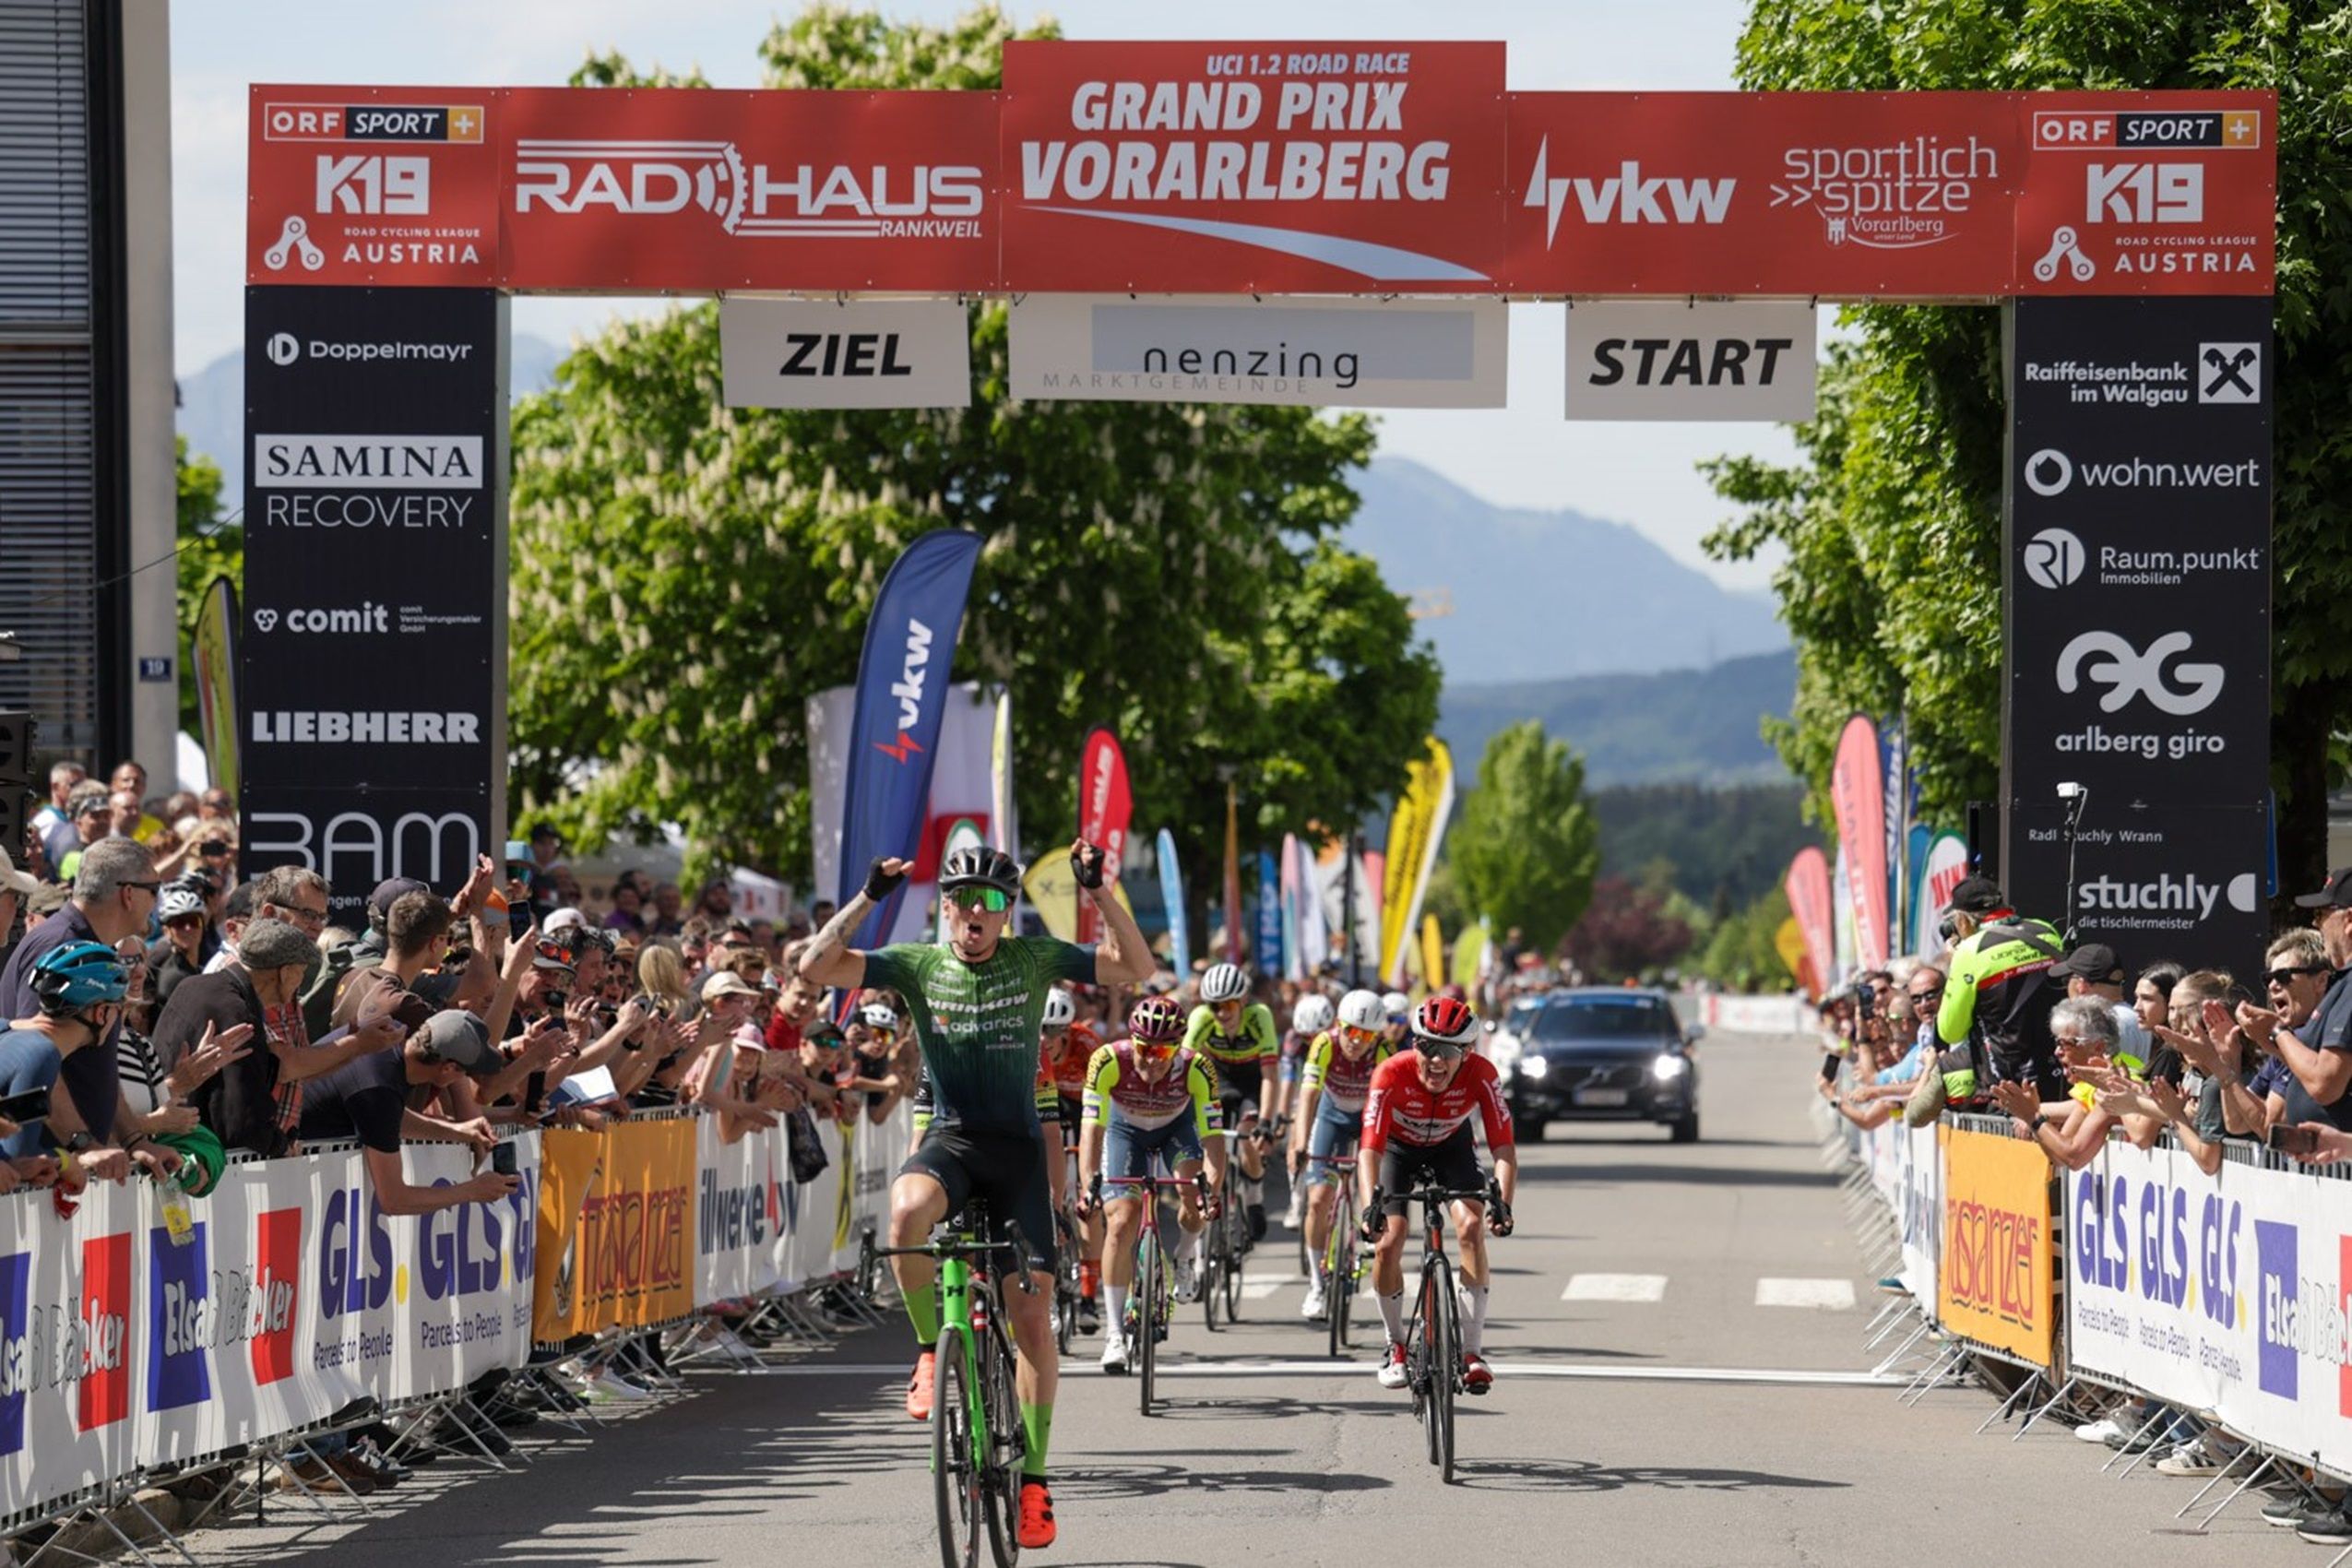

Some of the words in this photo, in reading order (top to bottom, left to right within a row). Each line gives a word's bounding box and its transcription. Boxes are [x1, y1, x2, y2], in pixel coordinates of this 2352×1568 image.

[1207, 55, 1242, 76] UCI
[1250, 54, 1280, 76] 1.2
[1287, 53, 1348, 75] ROAD
[1354, 53, 1410, 74] RACE
[1072, 81, 1262, 131] GRAND
[1277, 81, 1408, 131] PRIX
[272, 112, 341, 134] ORF
[355, 112, 441, 135] SPORT
[2041, 120, 2111, 141] ORF
[2125, 119, 2214, 140] SPORT
[1021, 140, 1450, 201] VORARLBERG
[1785, 137, 1999, 190] sportlich
[316, 155, 430, 215] K19
[1572, 160, 1737, 224] vkw
[1824, 172, 1971, 217] spitze
[2086, 163, 2204, 223] K19
[345, 227, 375, 237] ROAD
[381, 227, 432, 237] CYCLING
[436, 227, 481, 238] LEAGUE
[881, 220, 981, 238] RANKWEIL
[1851, 216, 1944, 236] Vorarlberg
[2116, 237, 2149, 245] ROAD
[2154, 237, 2205, 245] CYCLING
[2210, 237, 2257, 245] LEAGUE
[343, 242, 480, 264] AUSTRIA
[2114, 253, 2256, 273] AUSTRIA
[310, 339, 472, 362] Doppelmayr
[780, 333, 912, 376] ZIEL
[1144, 343, 1359, 387] nenzing
[1589, 339, 1793, 386] START
[1043, 373, 1308, 395] MARKTGEMEINDE
[2025, 362, 2189, 382] Raiffeisenbank
[2071, 385, 2097, 403] im
[2103, 384, 2189, 408] Walgau
[267, 445, 473, 478] SAMINA
[2081, 457, 2260, 487] wohn.wert
[267, 495, 472, 528] RECOVERY
[2100, 547, 2259, 574] Raum.punkt
[2100, 572, 2181, 585] Immobilien
[287, 601, 388, 633] comit
[891, 617, 933, 730] vkw
[252, 711, 480, 742] LIEBHERR
[2055, 725, 2159, 759] arlberg
[2168, 727, 2225, 759] giro
[2029, 829, 2057, 841] Radl
[2063, 829, 2113, 845] Suchly
[2119, 830, 2163, 842] Wrann
[2078, 873, 2221, 921] stuchly
[2078, 916, 2098, 928] die
[2100, 916, 2194, 929] tischlermeister
[950, 1015, 1025, 1033] advarics
[422, 1316, 461, 1349] Parcels
[463, 1317, 474, 1341] to
[475, 1311, 503, 1346] People
[315, 1341, 345, 1370] Parcels
[348, 1339, 358, 1362] to
[359, 1327, 393, 1365] People
